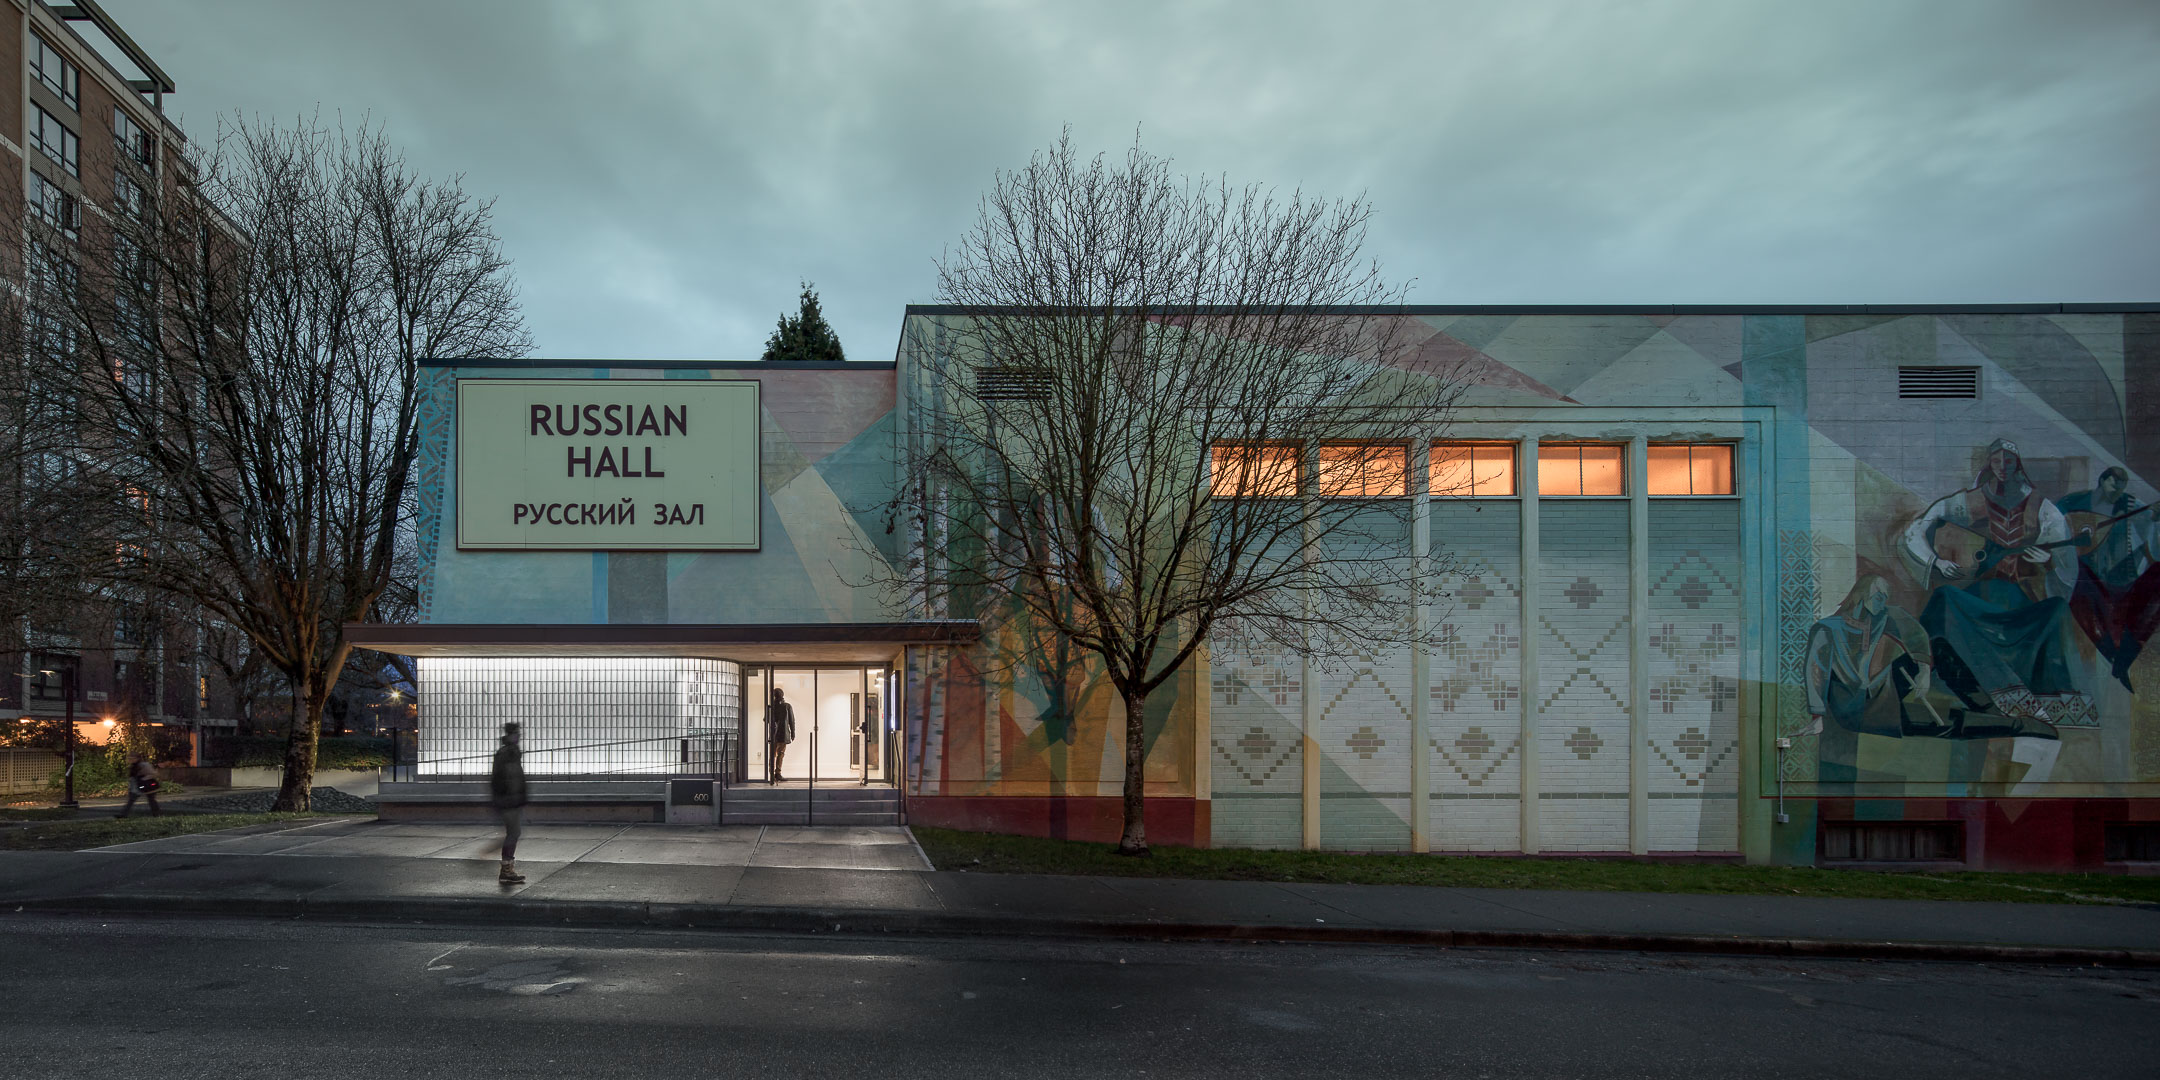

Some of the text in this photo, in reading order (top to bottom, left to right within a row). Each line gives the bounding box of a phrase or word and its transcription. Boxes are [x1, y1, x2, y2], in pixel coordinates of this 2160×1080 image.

[530, 404, 687, 436] RUSSIAN
[567, 446, 665, 478] HALL
[513, 498, 704, 525] РУССКИЙ ЗАЛ
[693, 793, 709, 801] 600
